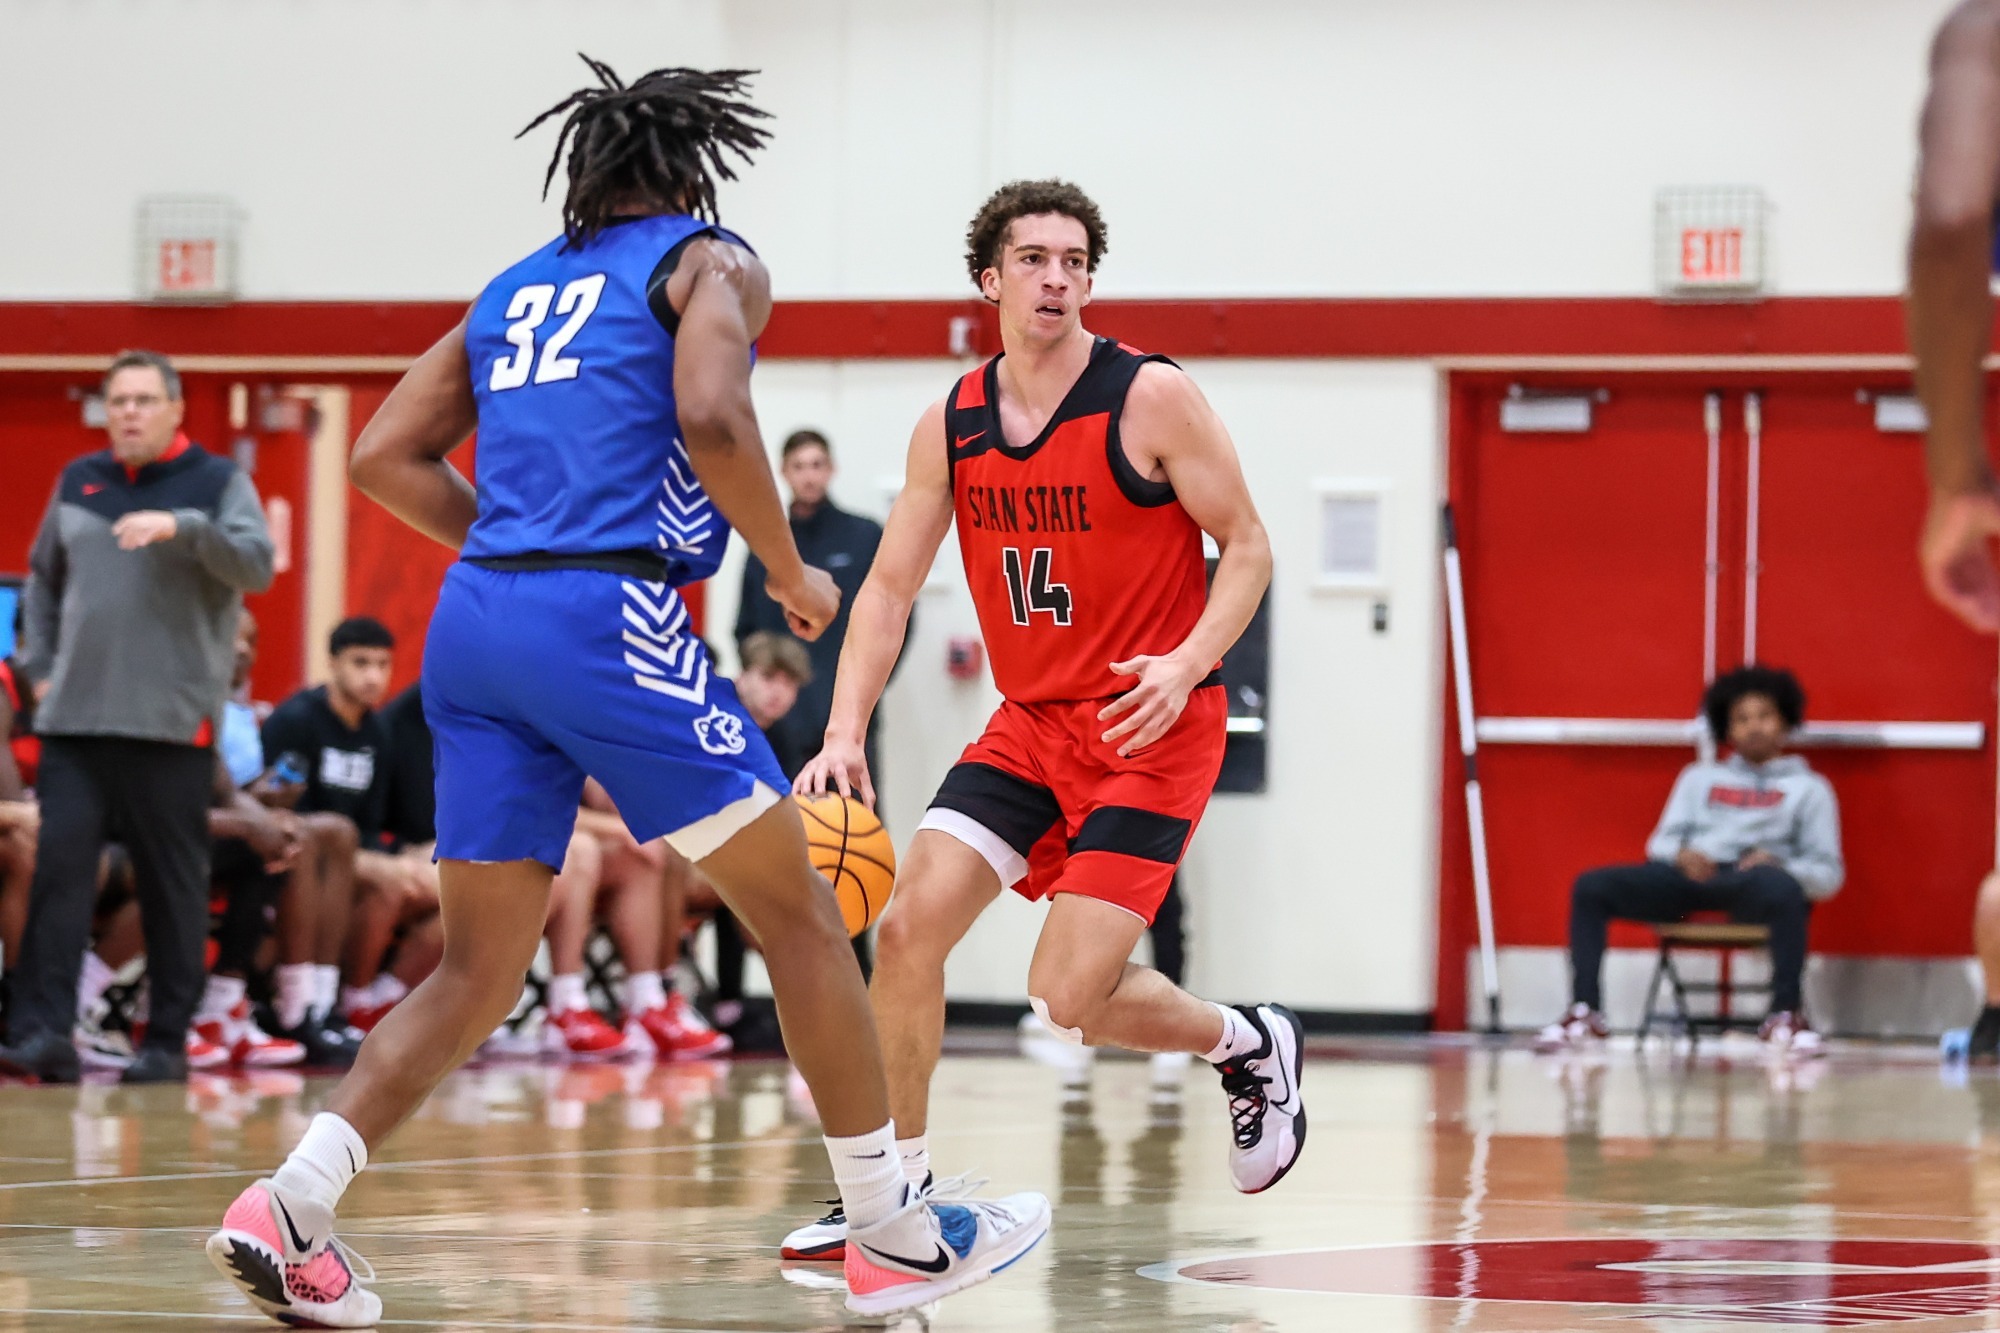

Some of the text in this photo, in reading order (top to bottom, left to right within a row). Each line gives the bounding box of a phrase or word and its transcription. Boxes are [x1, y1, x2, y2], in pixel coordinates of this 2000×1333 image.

[1682, 228, 1742, 280] EXIT
[489, 272, 607, 392] 32
[968, 485, 1092, 533] STAN STATE
[1002, 546, 1073, 626] 14
